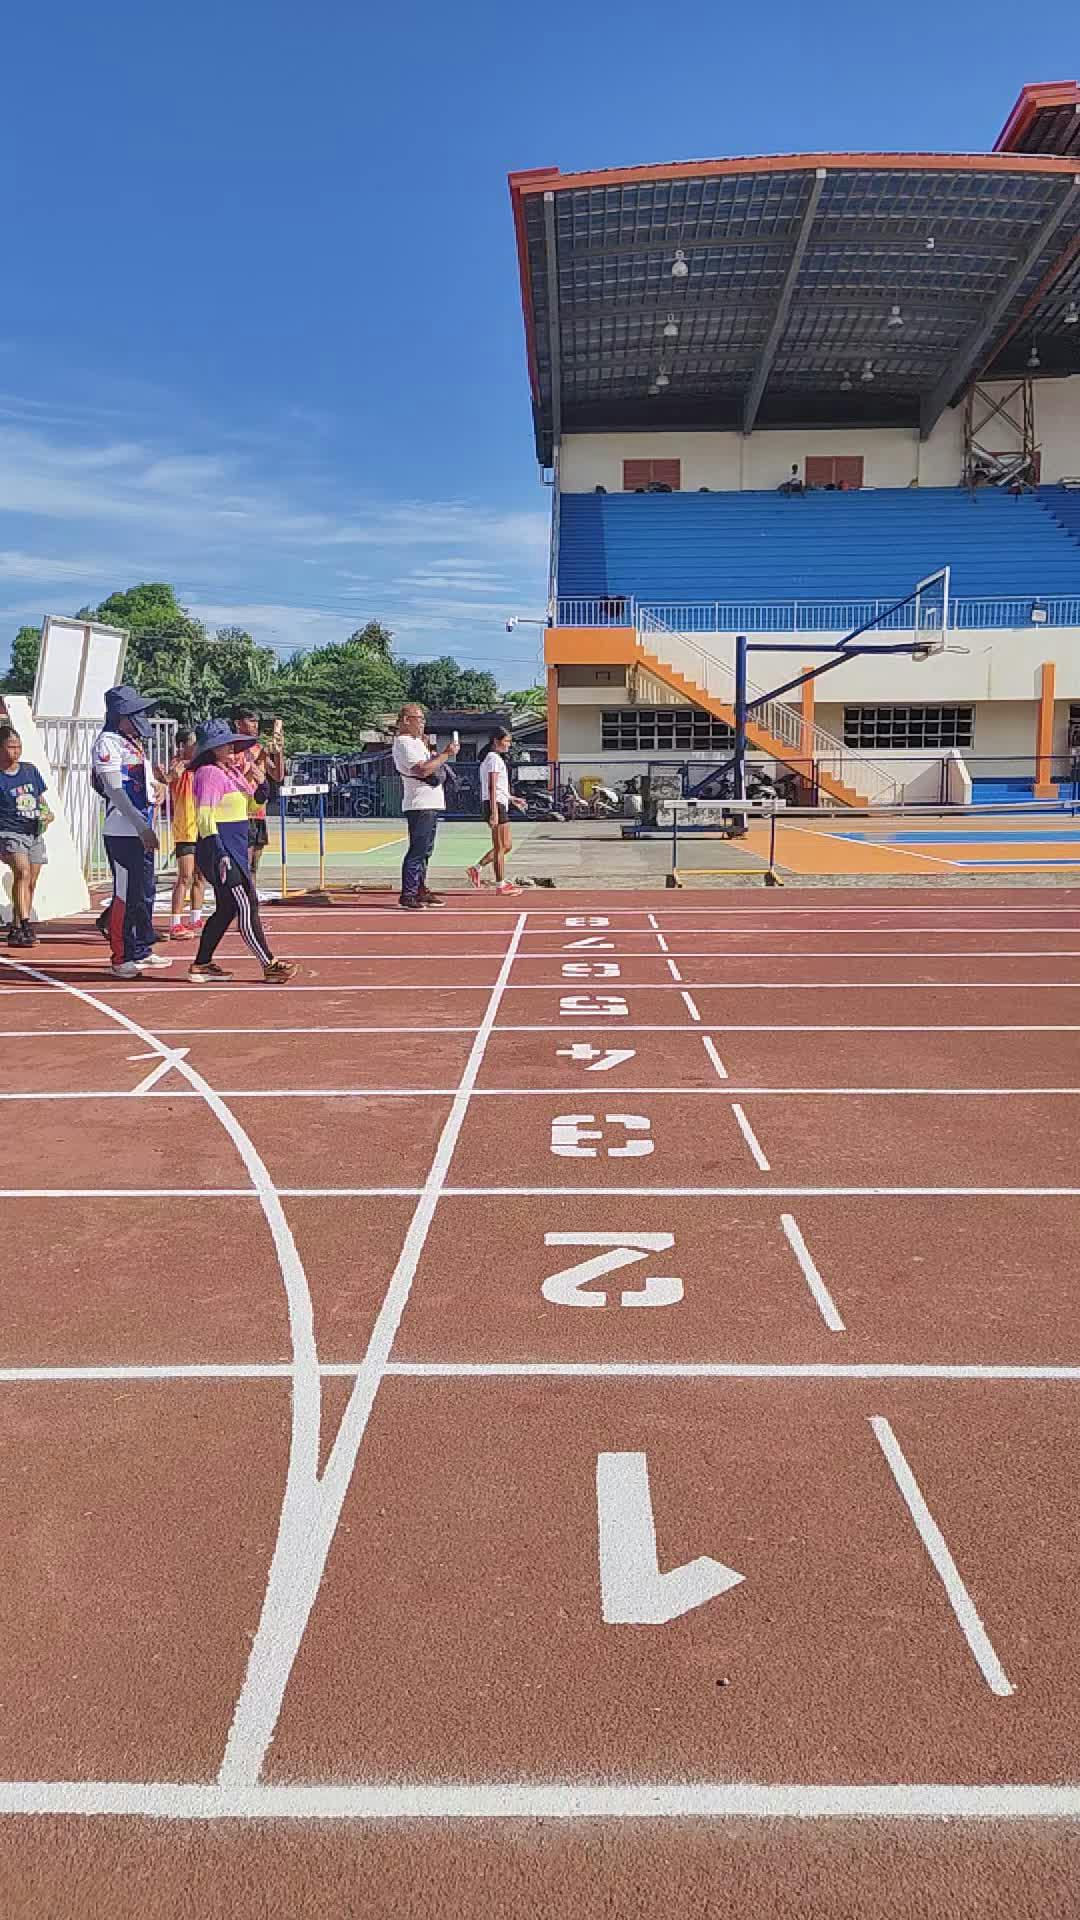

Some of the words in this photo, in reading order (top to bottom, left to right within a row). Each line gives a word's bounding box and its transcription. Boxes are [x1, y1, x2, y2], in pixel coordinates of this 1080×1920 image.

[564, 917, 609, 927] 8
[562, 937, 614, 948] 7
[562, 963, 620, 977] 6
[560, 995, 628, 1015] 5
[556, 1044, 636, 1070] 4
[550, 1114, 654, 1157] 3
[540, 1232, 684, 1307] 2
[596, 1452, 746, 1624] 1
